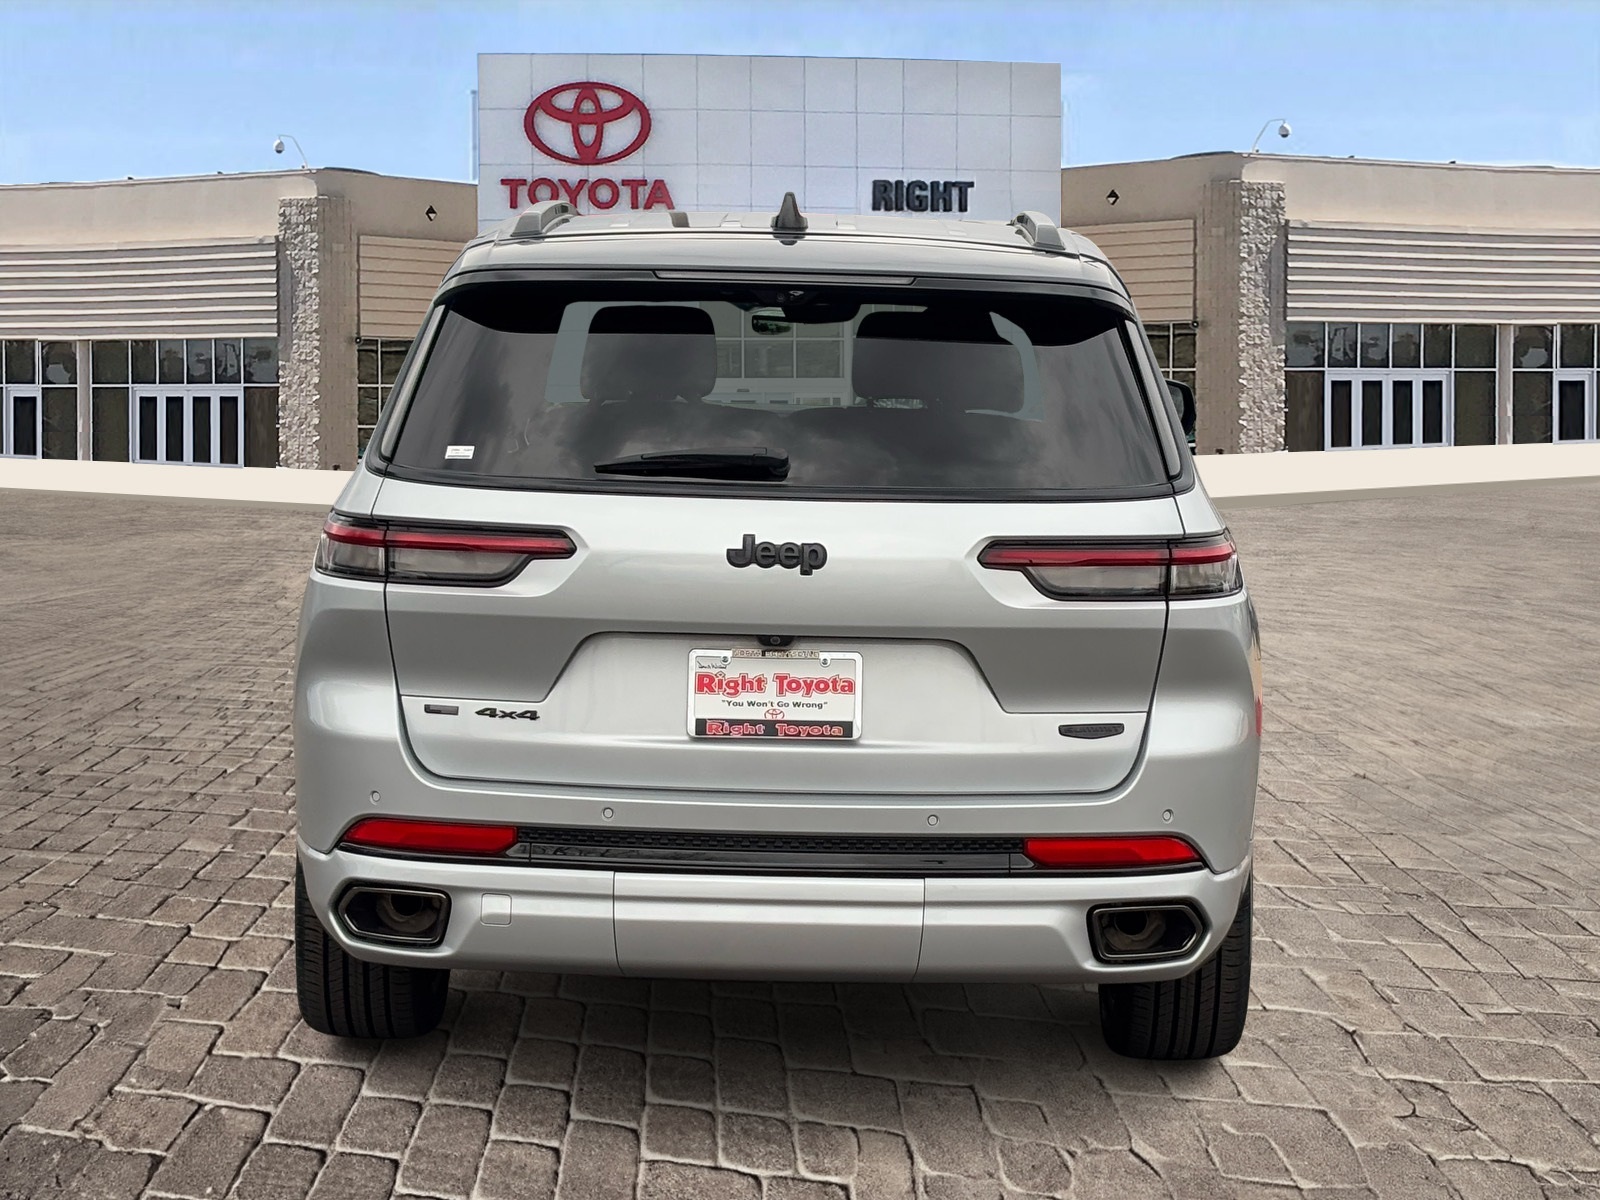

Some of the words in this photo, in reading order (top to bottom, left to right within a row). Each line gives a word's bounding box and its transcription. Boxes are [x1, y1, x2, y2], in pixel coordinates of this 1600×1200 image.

[500, 178, 675, 210] TOYOTA
[872, 179, 974, 212] RIGHT
[726, 534, 827, 575] Jeep
[695, 671, 767, 698] Right
[773, 673, 855, 698] Toyota
[475, 707, 540, 721] 4x4
[747, 700, 774, 708] Won't
[706, 720, 765, 736] Right
[775, 723, 844, 737] Toyota
